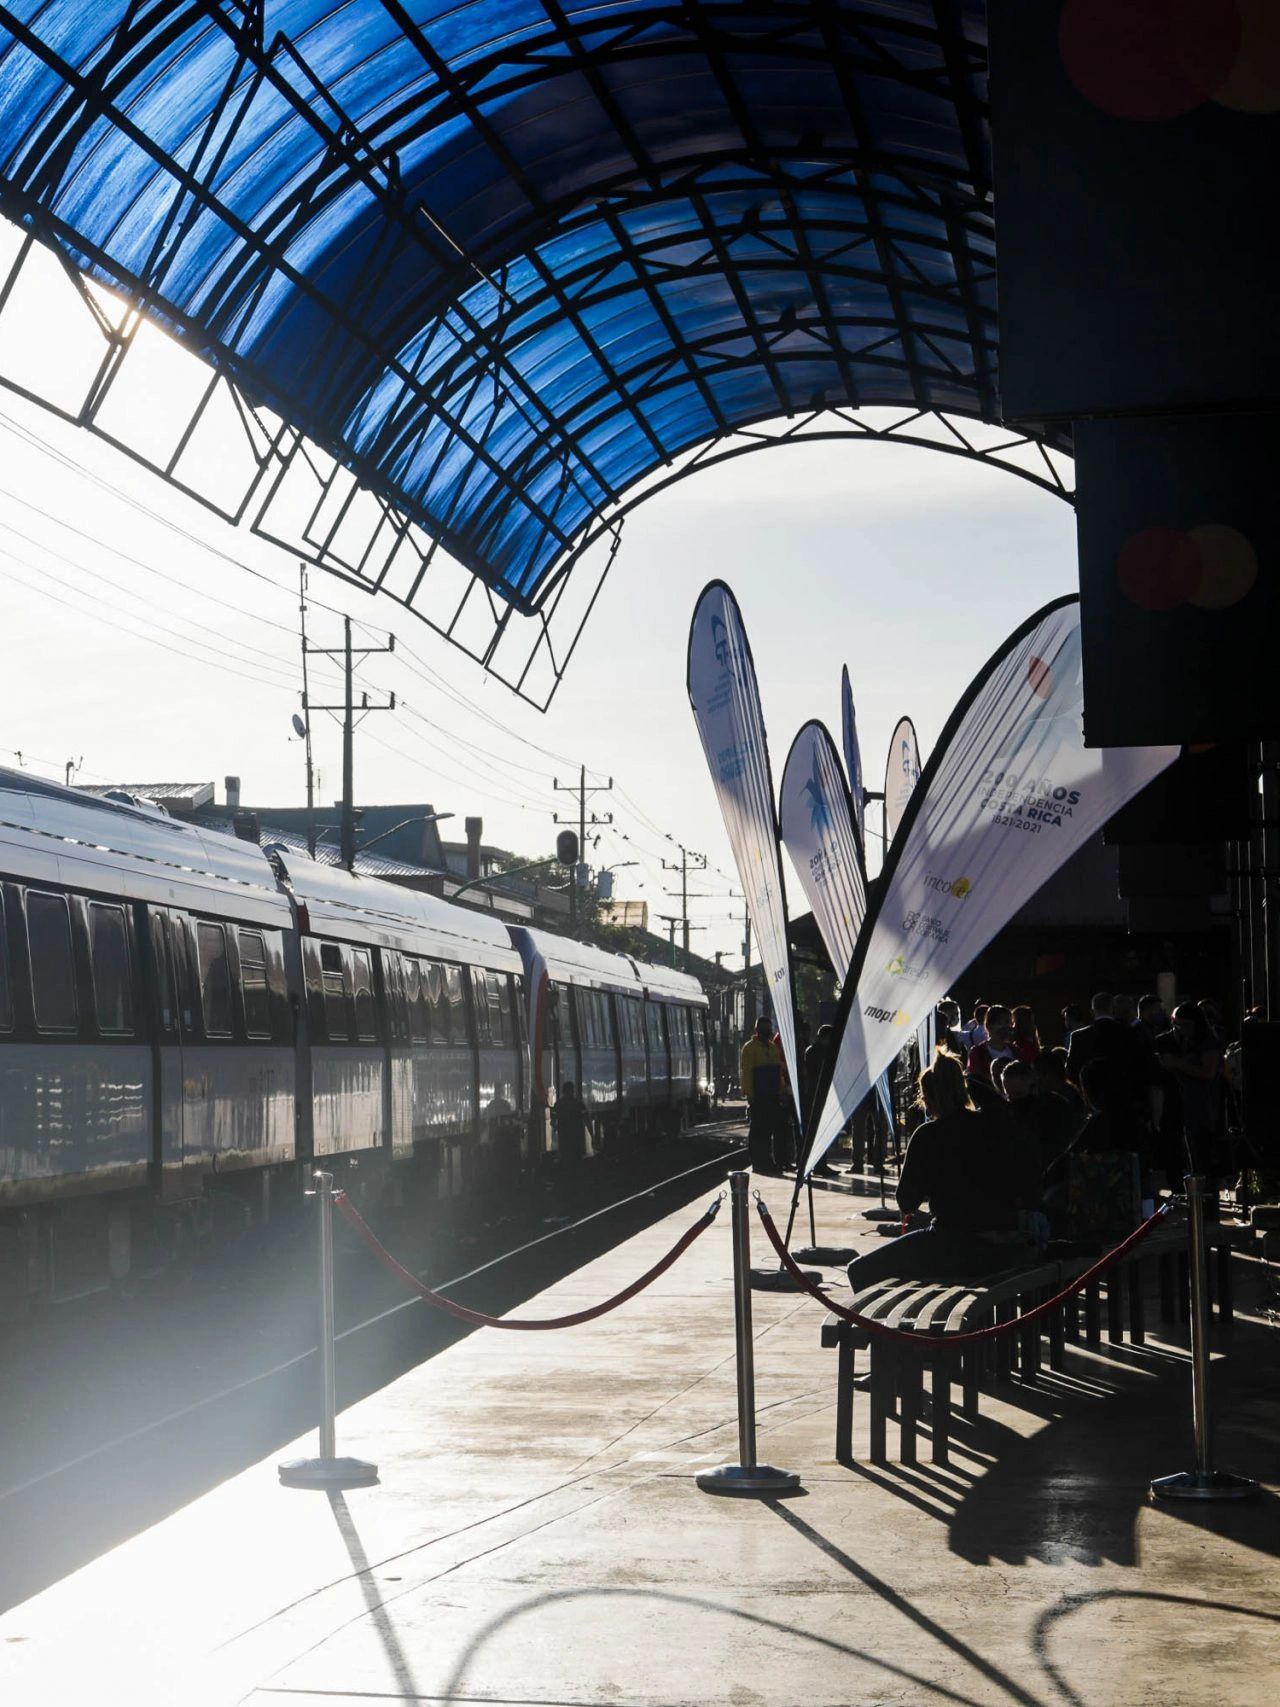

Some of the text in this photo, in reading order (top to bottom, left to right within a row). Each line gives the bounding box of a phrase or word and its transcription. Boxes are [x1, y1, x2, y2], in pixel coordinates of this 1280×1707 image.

[1023, 779, 1081, 805] AÑOS
[1027, 808, 1062, 827] RICA
[864, 1005, 897, 1023] mopt
